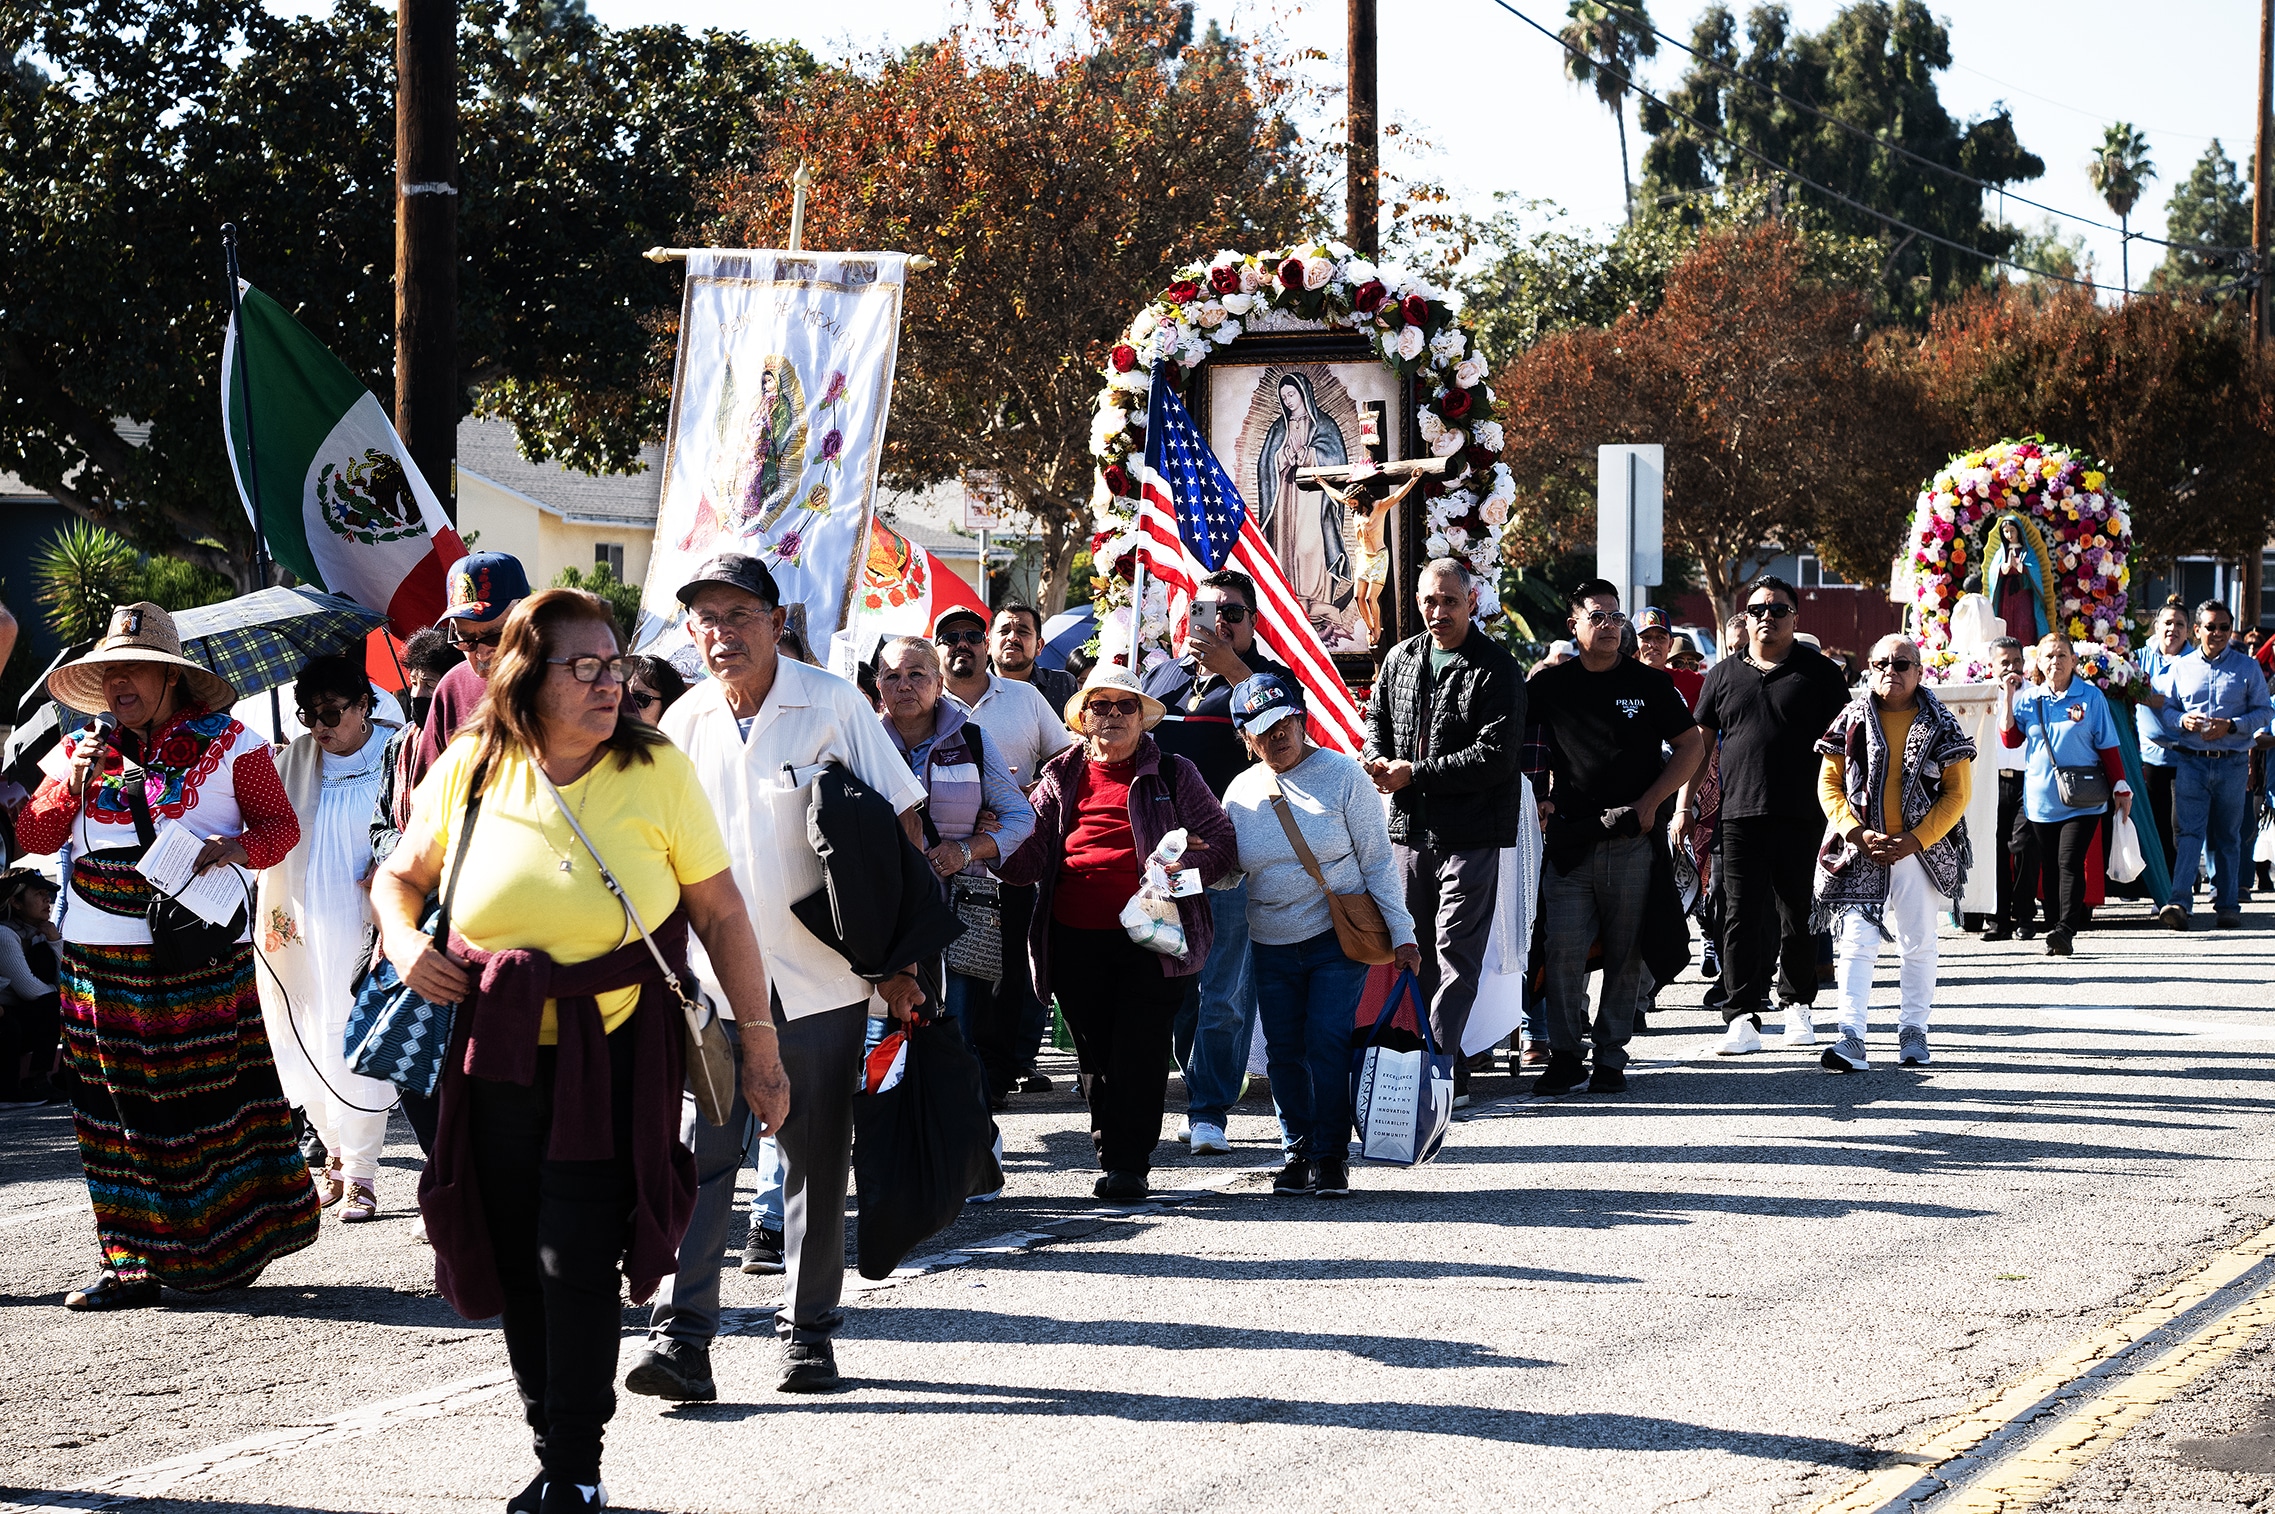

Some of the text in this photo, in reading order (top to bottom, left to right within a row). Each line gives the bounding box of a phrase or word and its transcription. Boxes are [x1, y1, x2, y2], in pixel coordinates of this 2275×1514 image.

[719, 310, 757, 338] REIN
[801, 306, 856, 351] MEXICO
[1243, 687, 1284, 714] MEXICO
[1616, 698, 1645, 707] PRADA
[1382, 1073, 1413, 1081] EXCELLENCE
[1380, 1084, 1412, 1092] INTEGRITY
[1378, 1095, 1411, 1103] EMPATHY
[1376, 1107, 1410, 1115] INNOVATION
[1374, 1119, 1409, 1127] RELIABILITY
[1373, 1130, 1408, 1139] COMMUNITY
